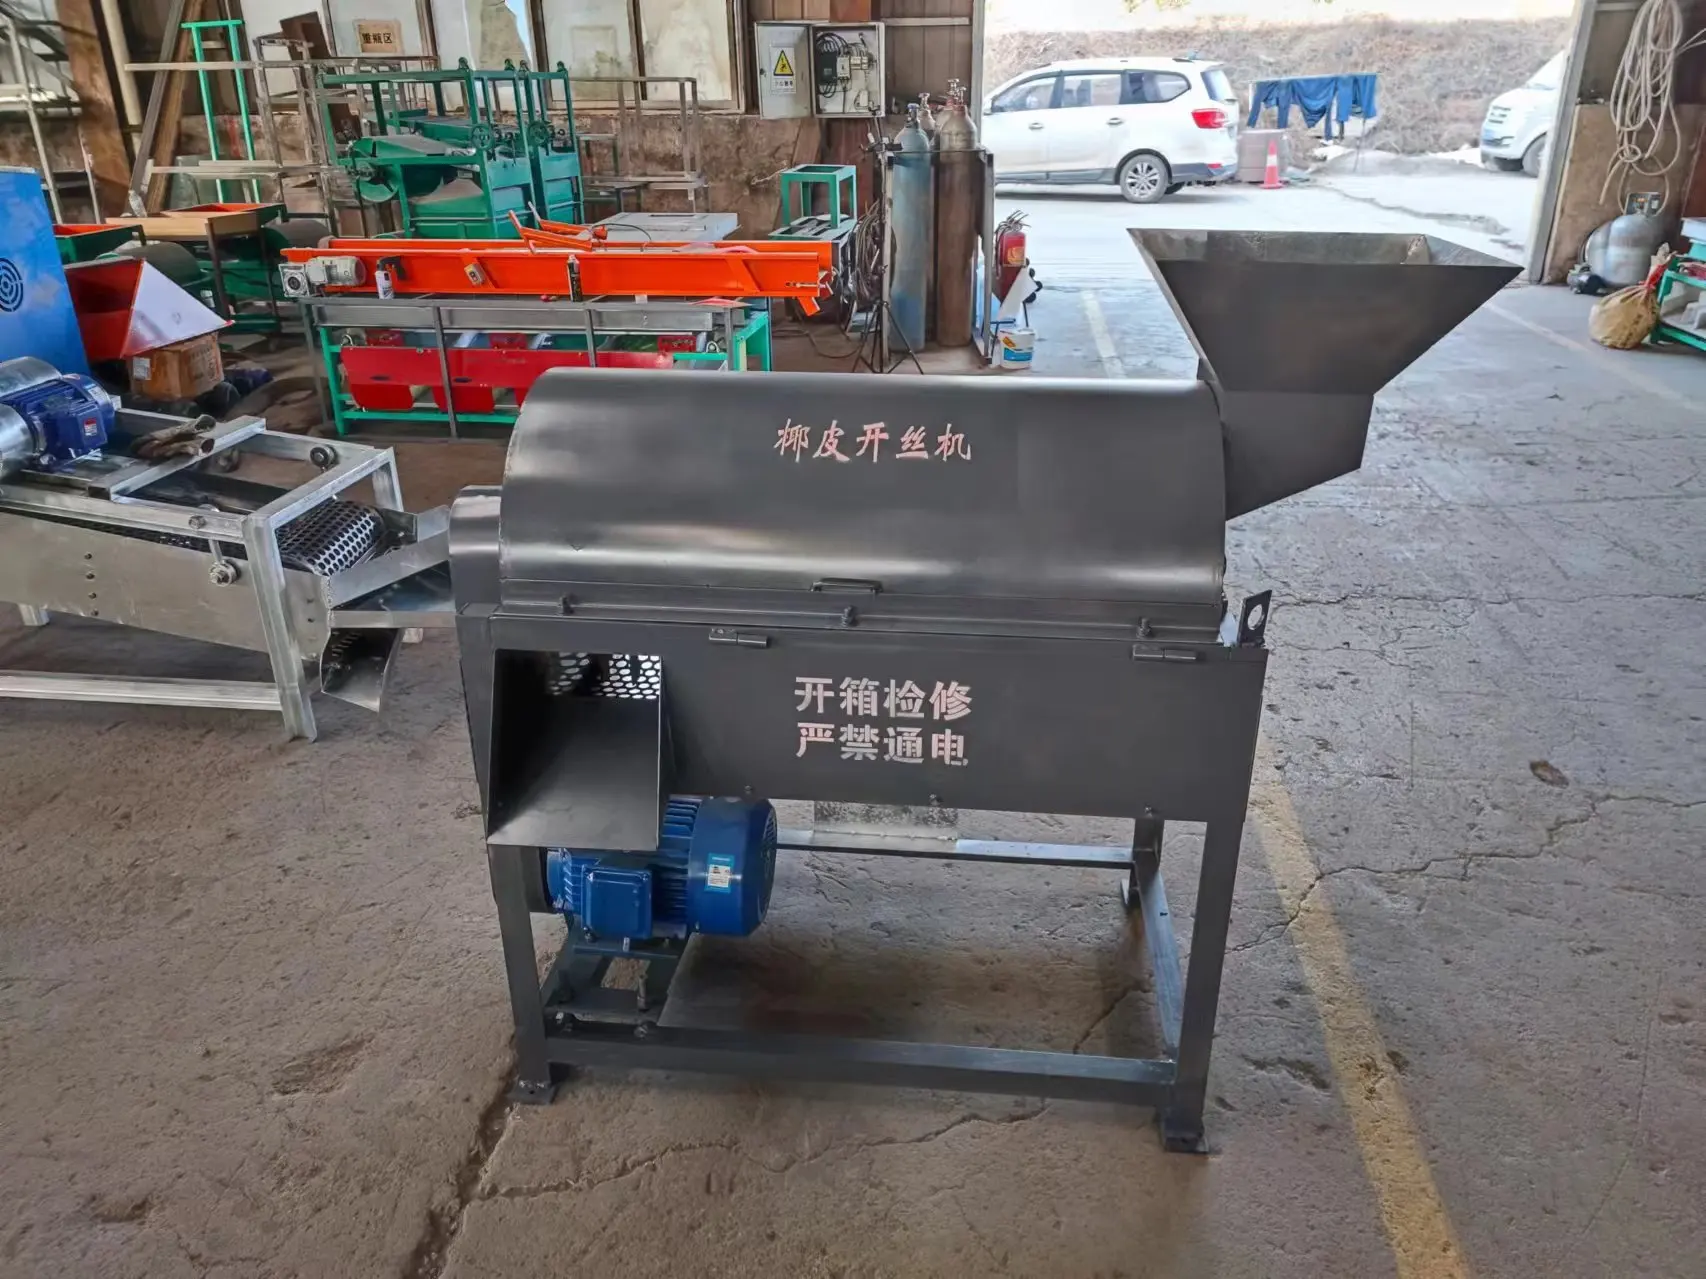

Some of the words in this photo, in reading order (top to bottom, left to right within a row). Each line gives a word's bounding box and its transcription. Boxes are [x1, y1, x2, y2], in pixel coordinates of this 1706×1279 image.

[773, 418, 972, 464] 椰皮开丝机
[794, 676, 973, 721] 开箱检修
[795, 722, 969, 766] 严禁通电
